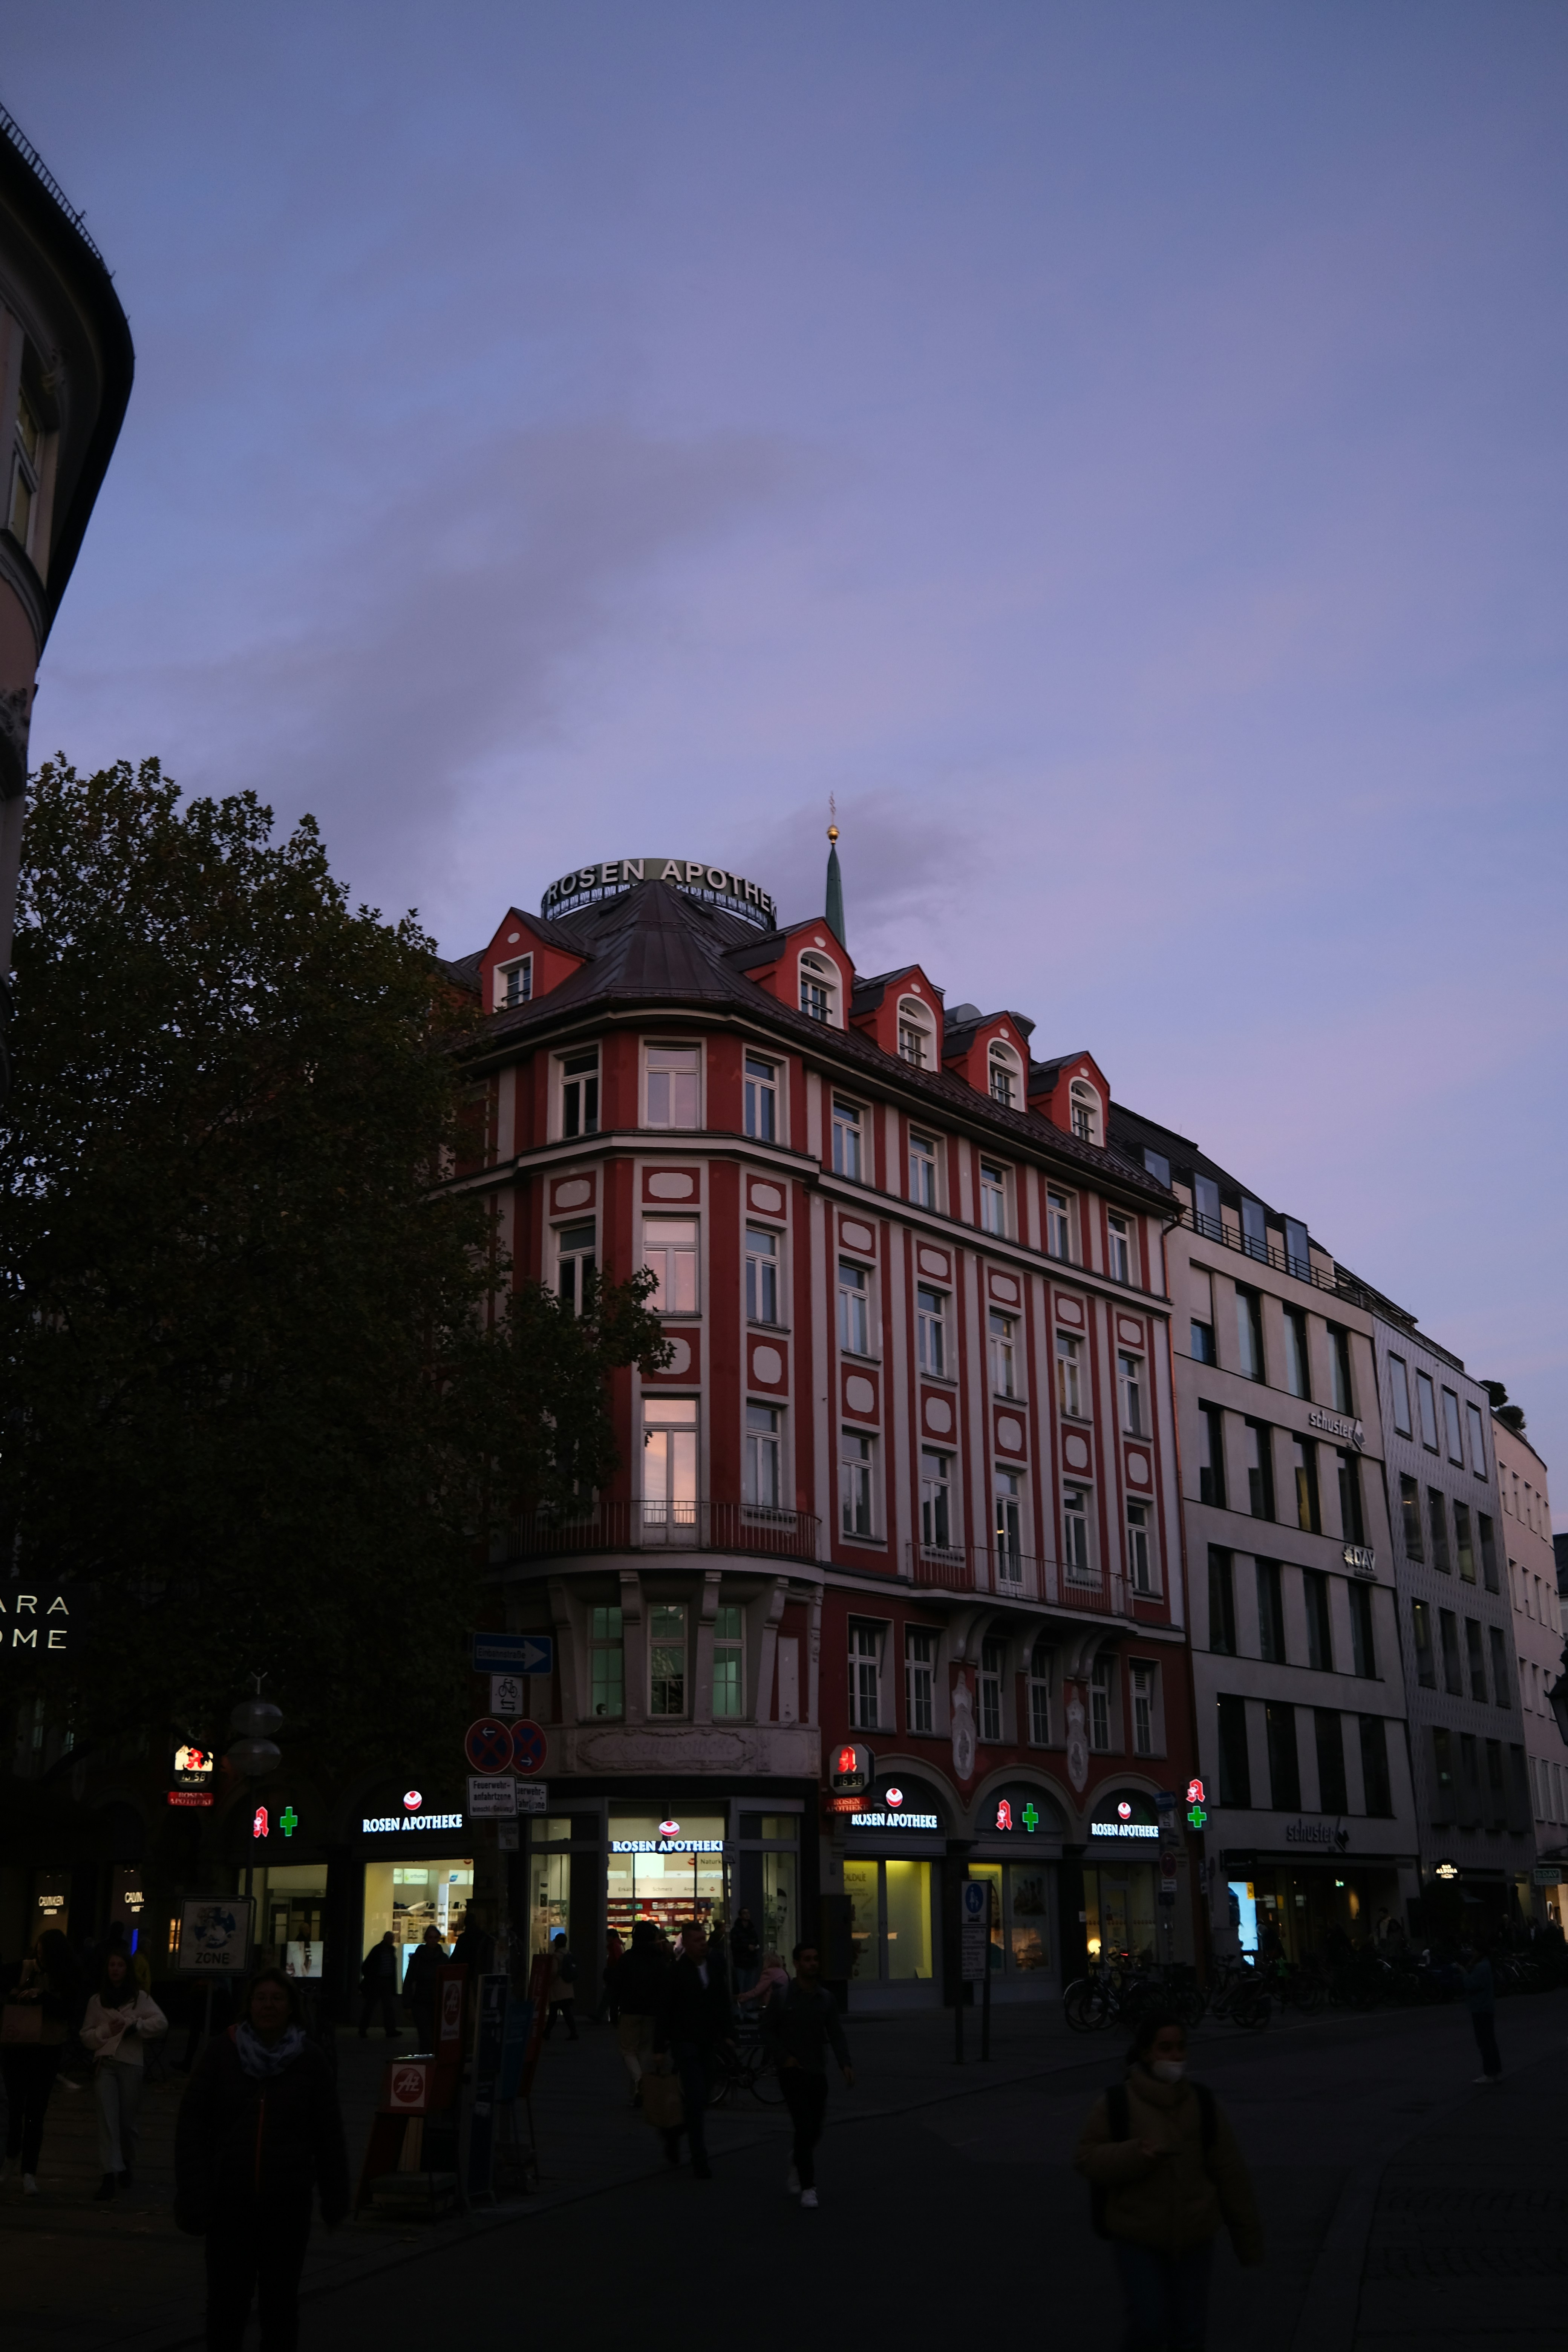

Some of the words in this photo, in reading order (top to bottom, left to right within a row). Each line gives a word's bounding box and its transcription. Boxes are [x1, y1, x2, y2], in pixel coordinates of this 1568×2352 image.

[548, 859, 645, 905] ROSEN
[1309, 1410, 1355, 1439] schuster
[1354, 1547, 1376, 1570] DAV
[0, 1595, 69, 1615] RA
[0, 1628, 67, 1649] ME
[478, 1648, 526, 1659] Einbahnstraße
[473, 1781, 510, 1789] Feuerwehr-
[826, 1804, 869, 1812] APOTHEKE
[362, 1818, 400, 1833] ROSEN
[401, 1814, 462, 1831] APOTHEKE
[851, 1813, 885, 1826] ROSEN
[886, 1814, 937, 1828] APOTHEKE
[1092, 1823, 1118, 1836] ROSEN
[1119, 1824, 1159, 1838] APOTHEKE
[1286, 1818, 1334, 1843] schuster
[612, 1841, 656, 1852] ROSEN
[195, 1952, 230, 1964] ZONE
